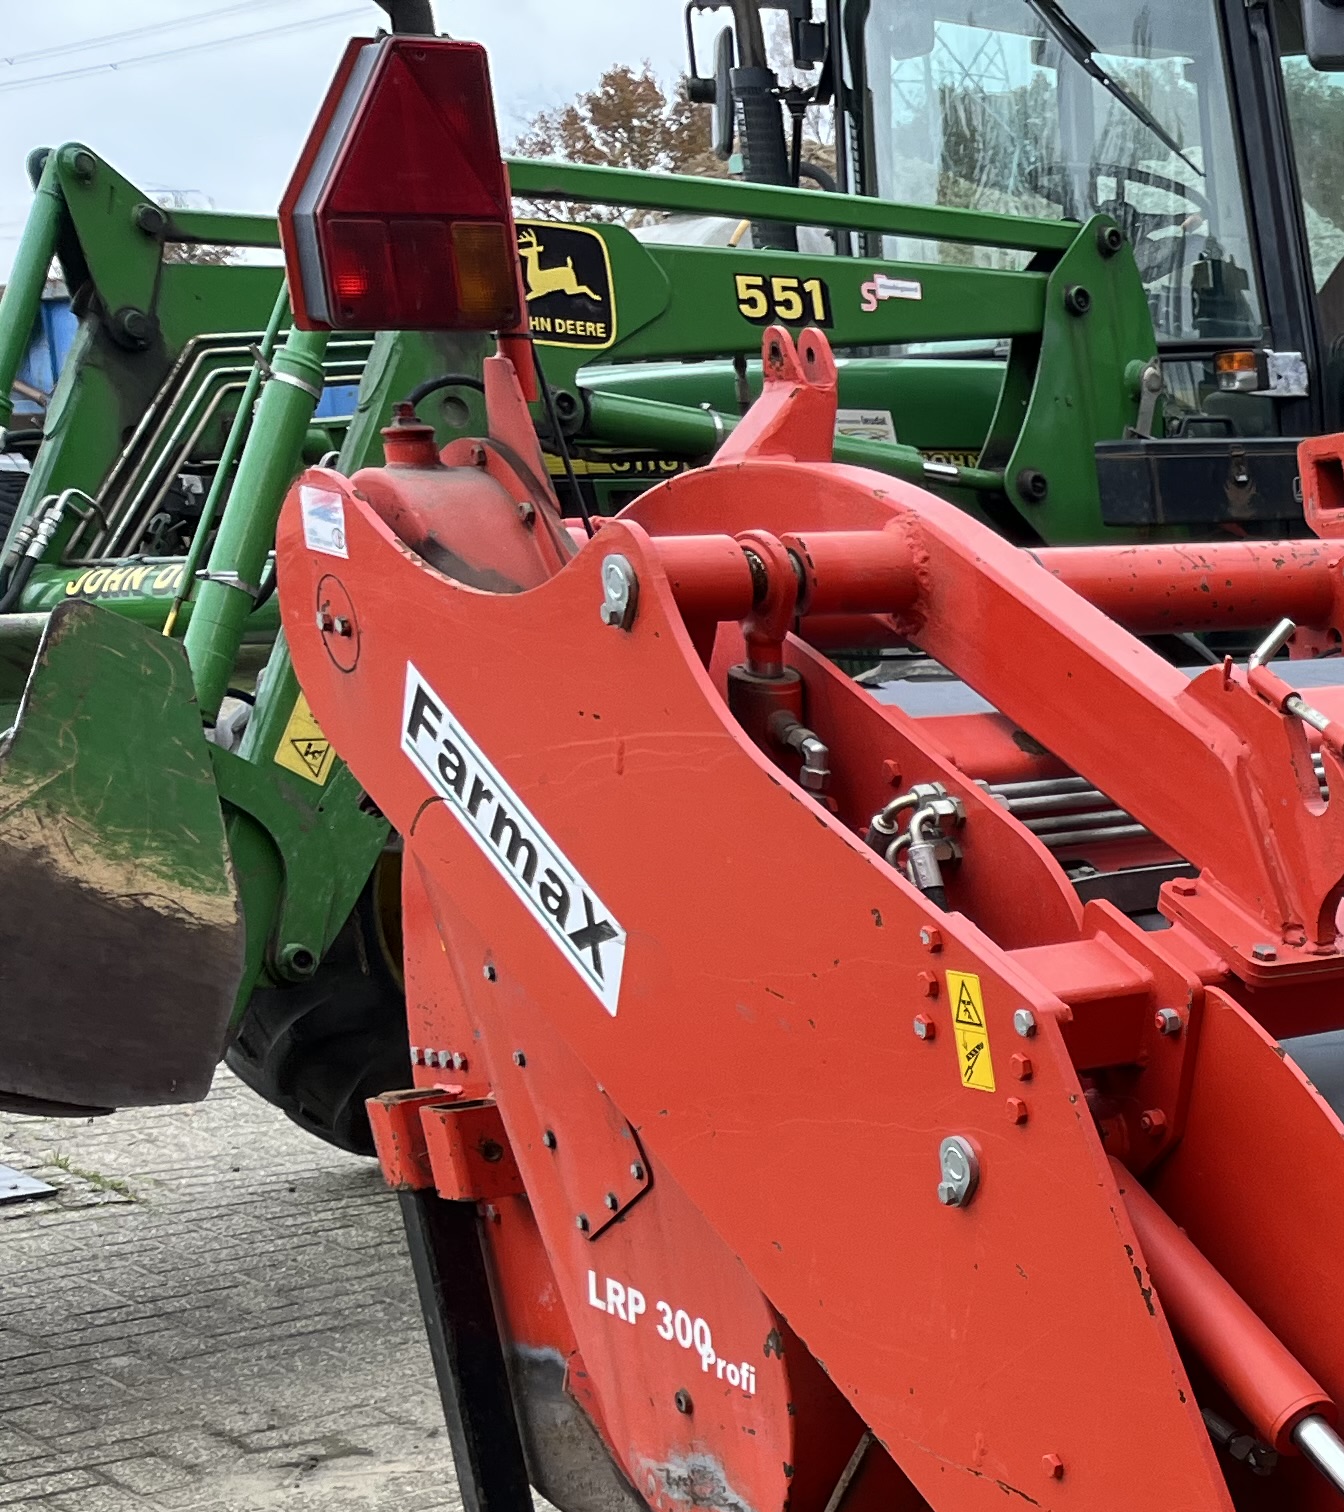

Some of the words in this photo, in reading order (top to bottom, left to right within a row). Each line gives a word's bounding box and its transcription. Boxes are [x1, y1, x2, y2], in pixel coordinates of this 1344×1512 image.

[734, 274, 827, 322] 551
[529, 316, 552, 333] HN
[554, 318, 607, 338] DEERE
[65, 565, 156, 596] JOHN
[587, 1270, 646, 1325] LRP
[655, 1300, 713, 1357] 300
[701, 1347, 757, 1395] Profi
